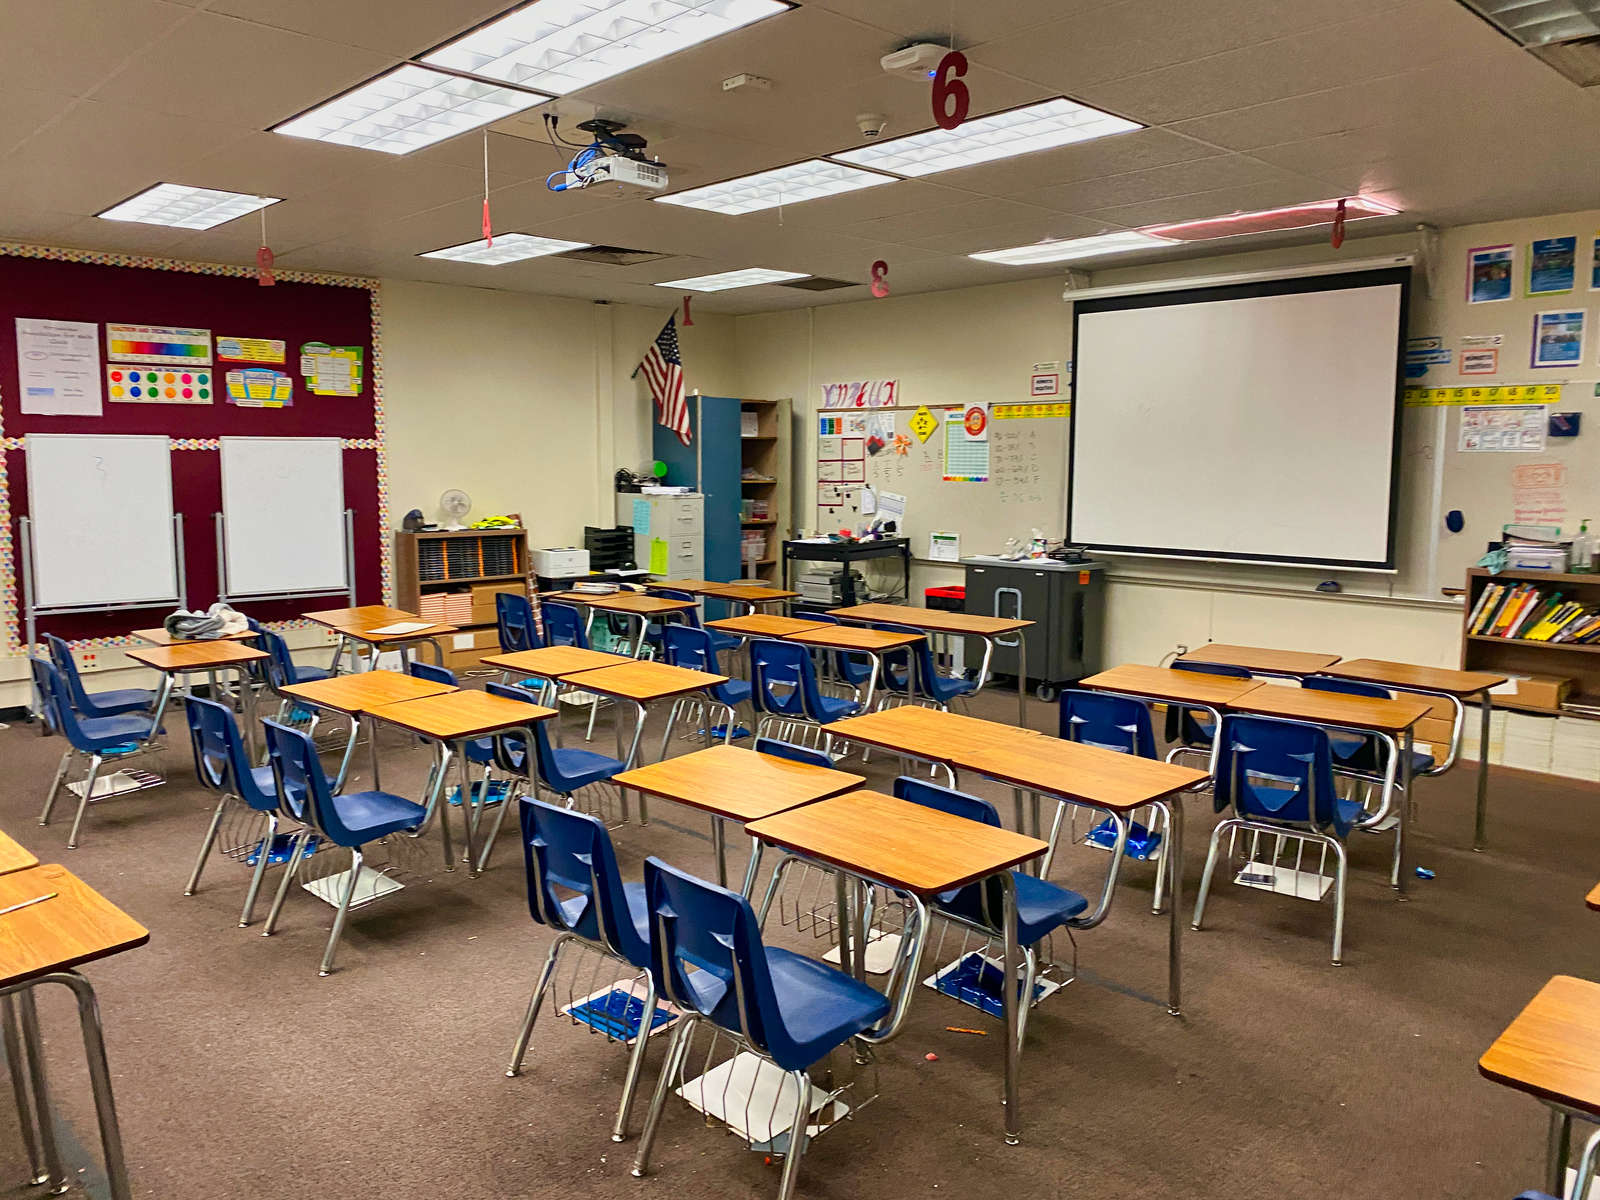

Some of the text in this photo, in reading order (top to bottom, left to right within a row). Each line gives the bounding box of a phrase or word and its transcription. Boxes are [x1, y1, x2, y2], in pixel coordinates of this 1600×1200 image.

[932, 51, 969, 130] 6
[871, 260, 889, 298] 3
[1471, 389, 1481, 397] 16
[1489, 388, 1499, 396] 17
[1507, 387, 1518, 396] 18
[1526, 387, 1536, 395] 19
[1545, 386, 1557, 395] 20
